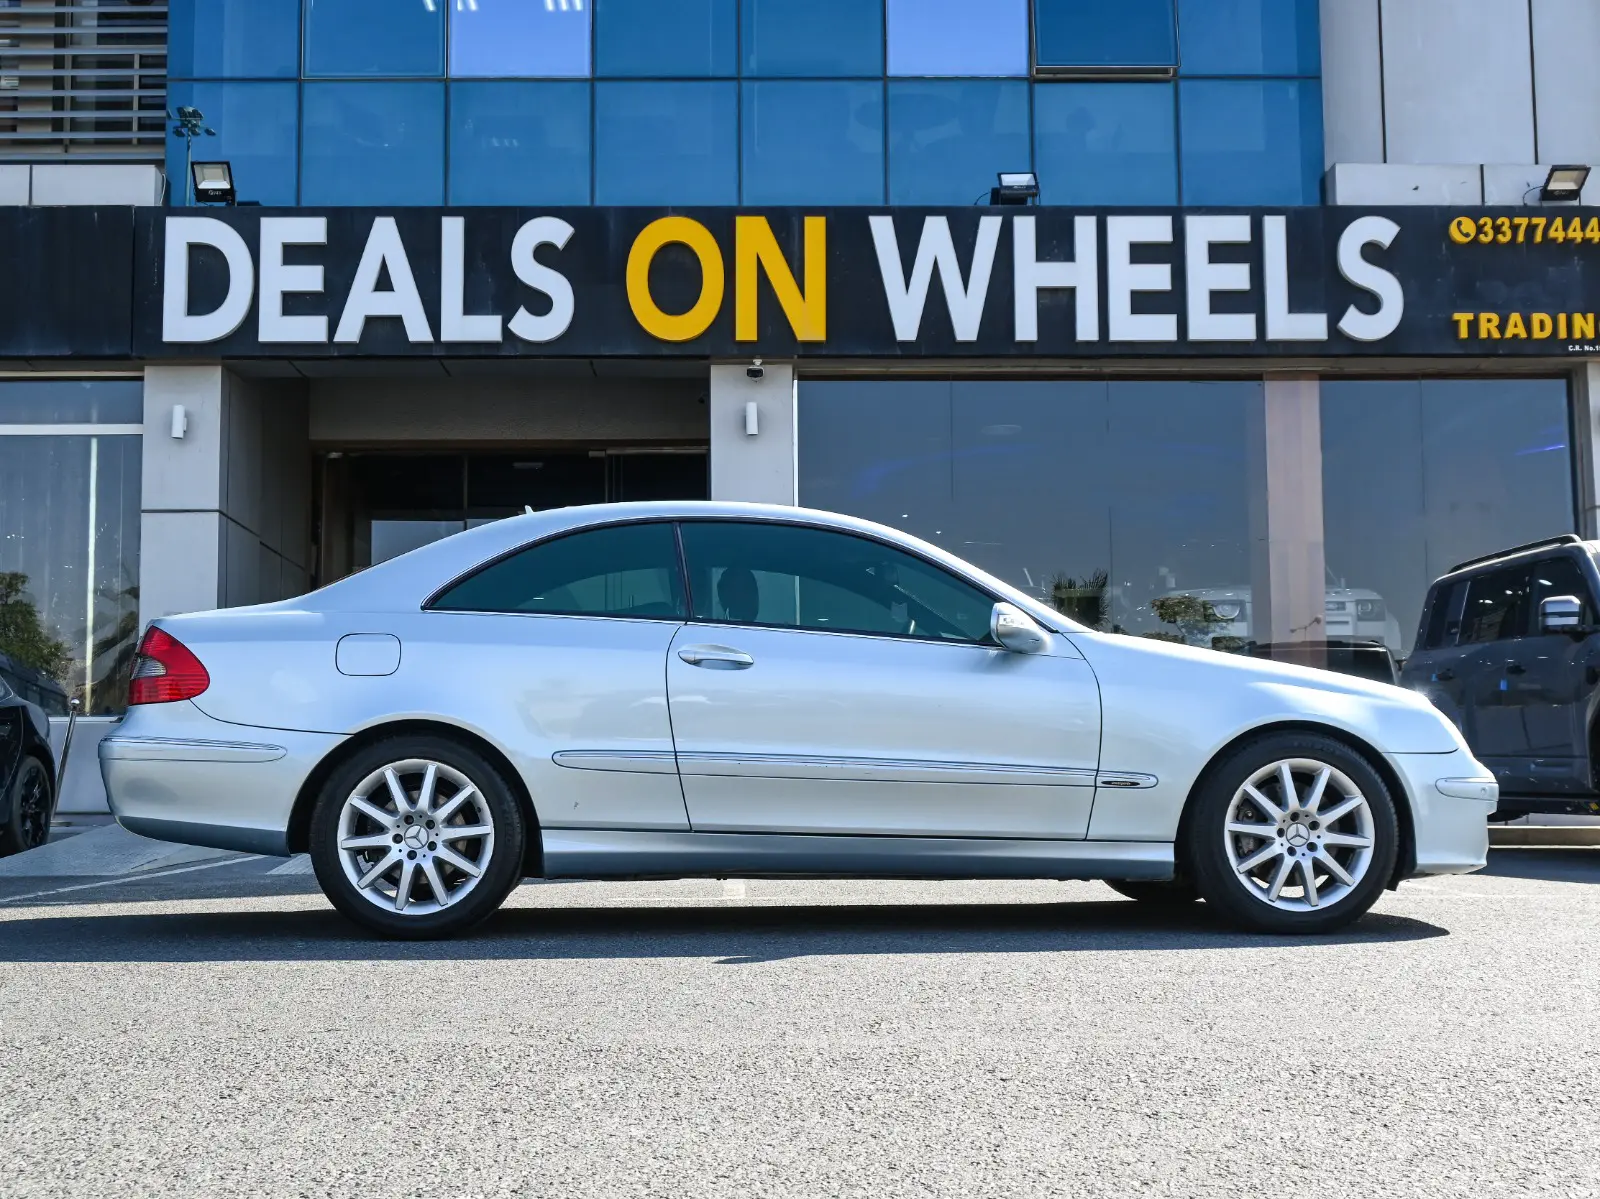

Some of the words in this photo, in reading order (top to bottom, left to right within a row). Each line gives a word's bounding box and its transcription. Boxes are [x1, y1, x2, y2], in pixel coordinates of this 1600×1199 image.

[162, 216, 575, 343] DEALS
[626, 215, 827, 342] ON
[868, 215, 1404, 342] WHEELS
[1451, 312, 1600, 340] TRADIN
